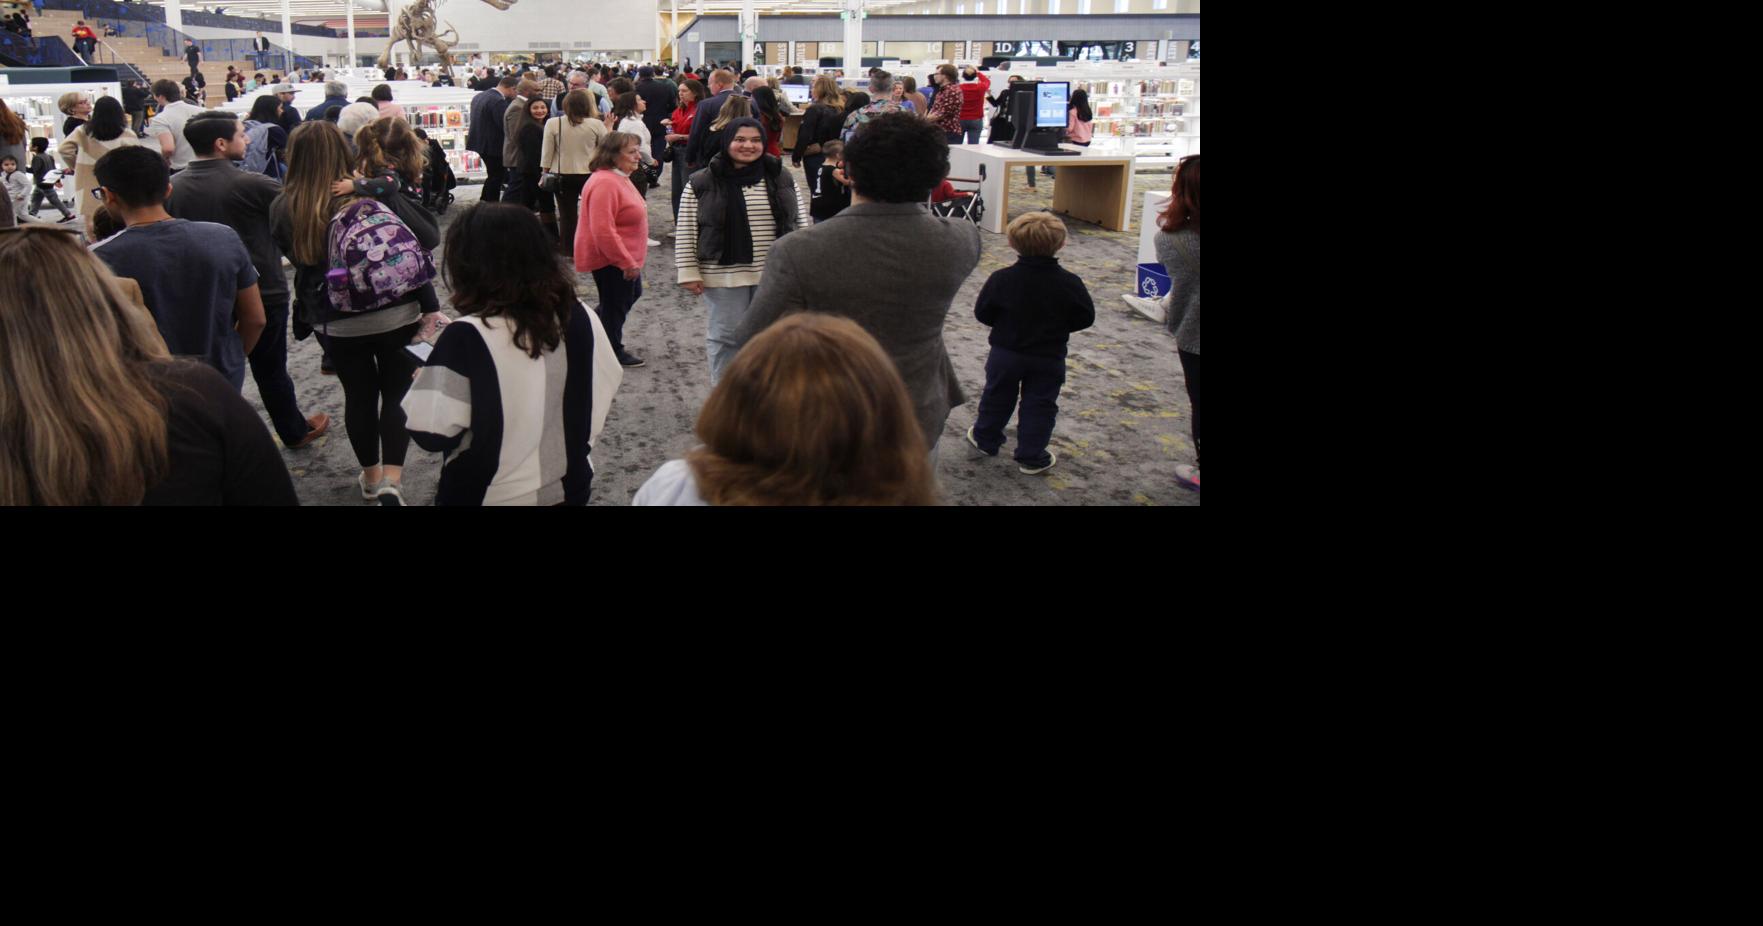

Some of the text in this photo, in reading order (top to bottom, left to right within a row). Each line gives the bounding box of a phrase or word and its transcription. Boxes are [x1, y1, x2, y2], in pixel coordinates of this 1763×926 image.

[995, 42, 1012, 53] 1D
[1124, 41, 1134, 53] 3
[1190, 41, 1200, 52] 4
